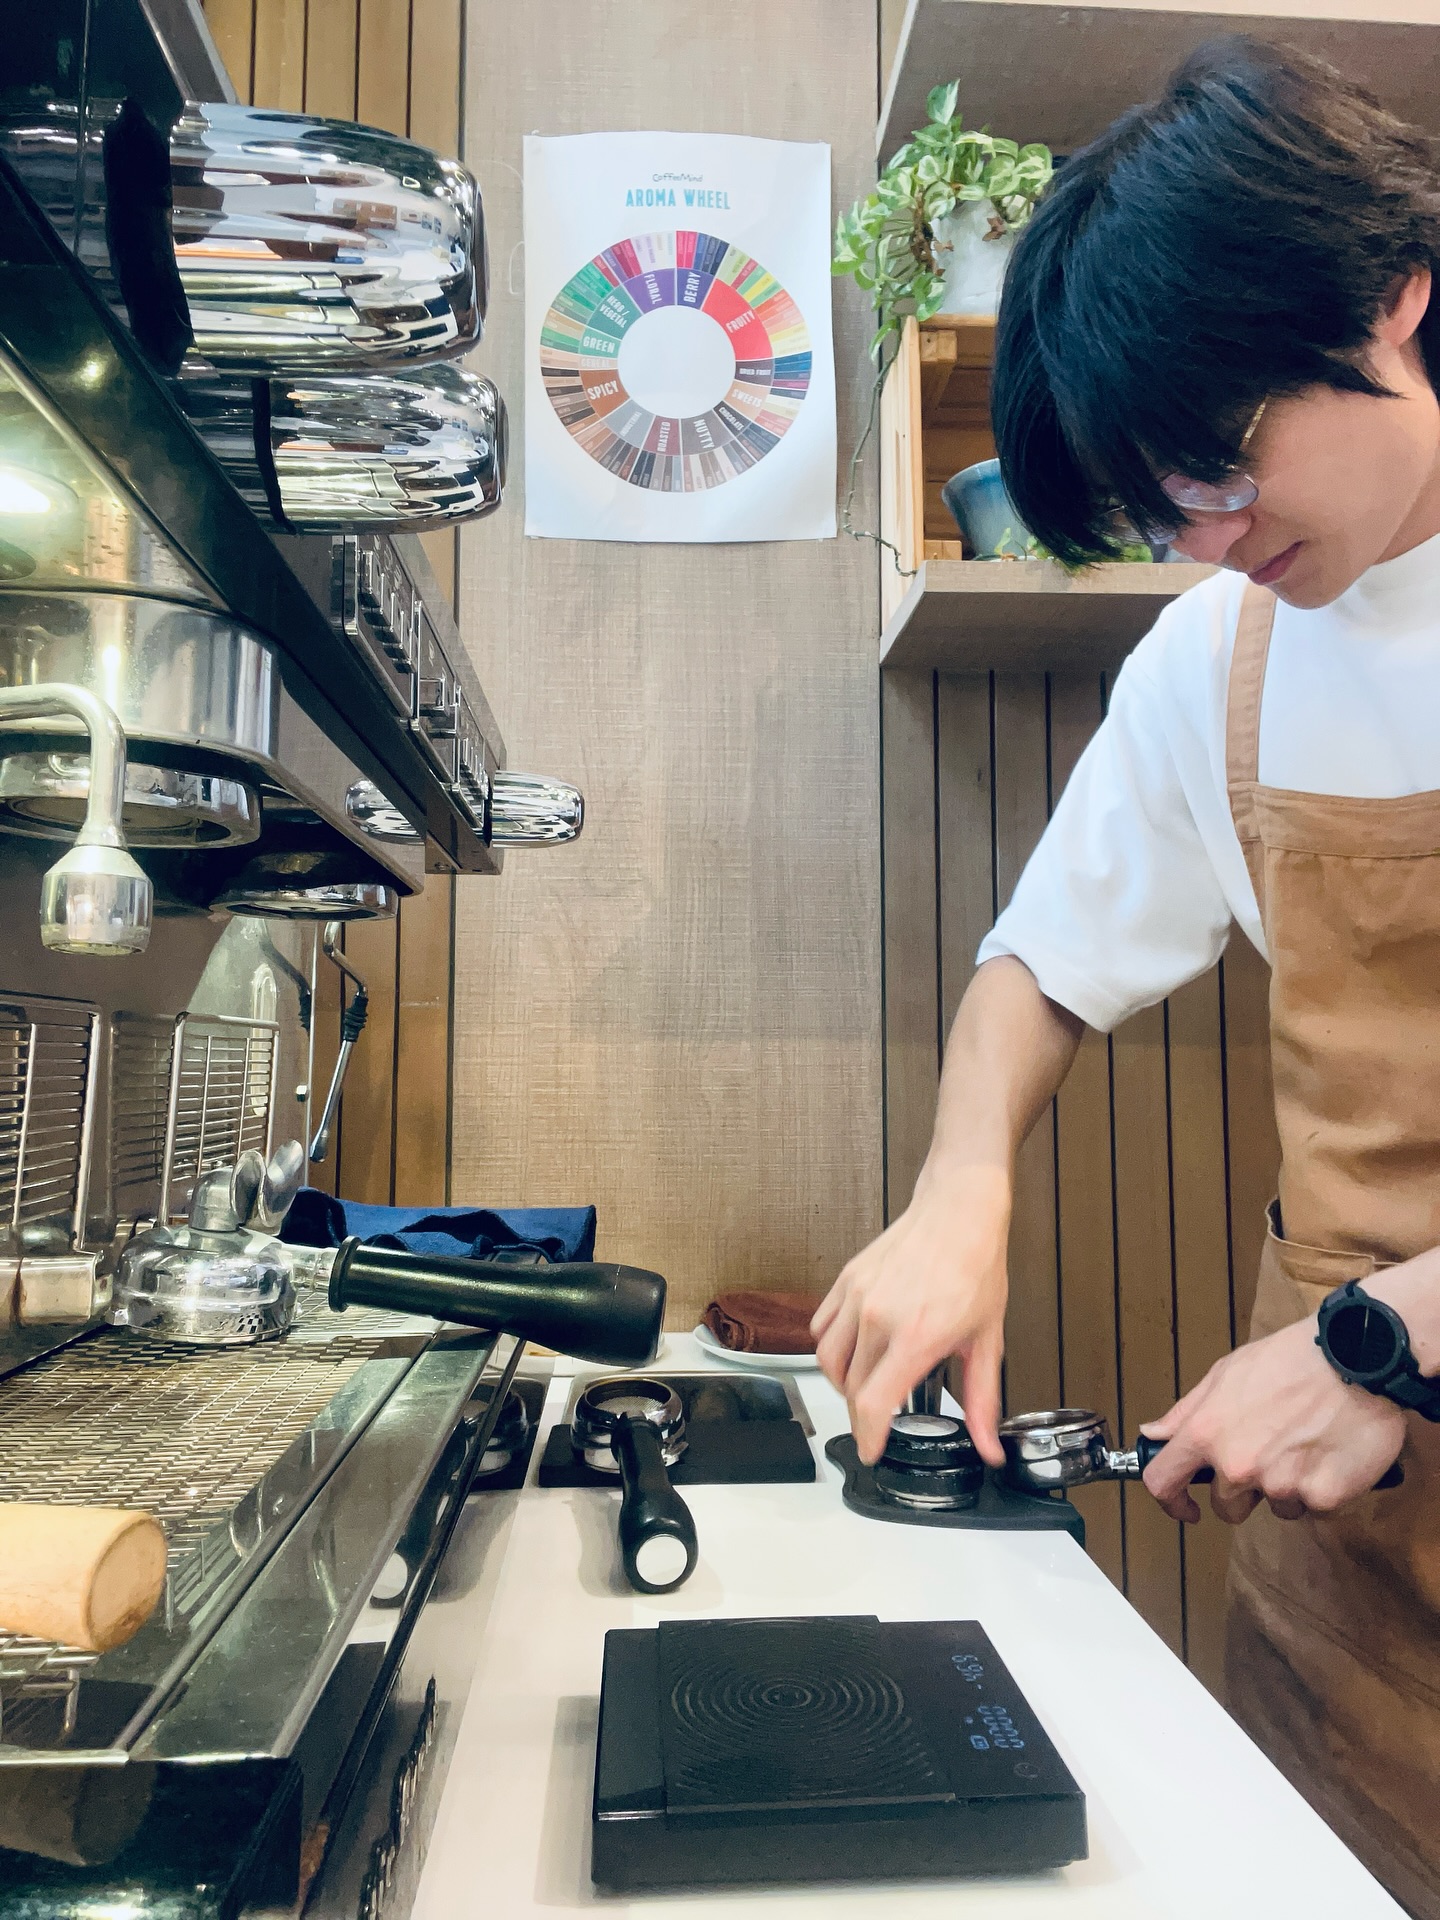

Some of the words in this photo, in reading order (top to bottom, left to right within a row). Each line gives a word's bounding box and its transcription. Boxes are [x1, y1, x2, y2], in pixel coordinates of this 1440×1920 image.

[625, 188, 677, 208] AROMA
[683, 188, 731, 210] WHEEL
[644, 272, 663, 305] FLORAL
[683, 271, 702, 304] BERRY
[599, 304, 629, 329] VEGETAL
[725, 309, 756, 334] FRUITY
[583, 336, 616, 354] GREEN
[587, 380, 620, 401] SPICY
[731, 388, 763, 408] SWEETS
[718, 406, 745, 432] CHOCOLATE
[656, 421, 672, 453] ROASTED
[693, 418, 716, 450] NUTTY
